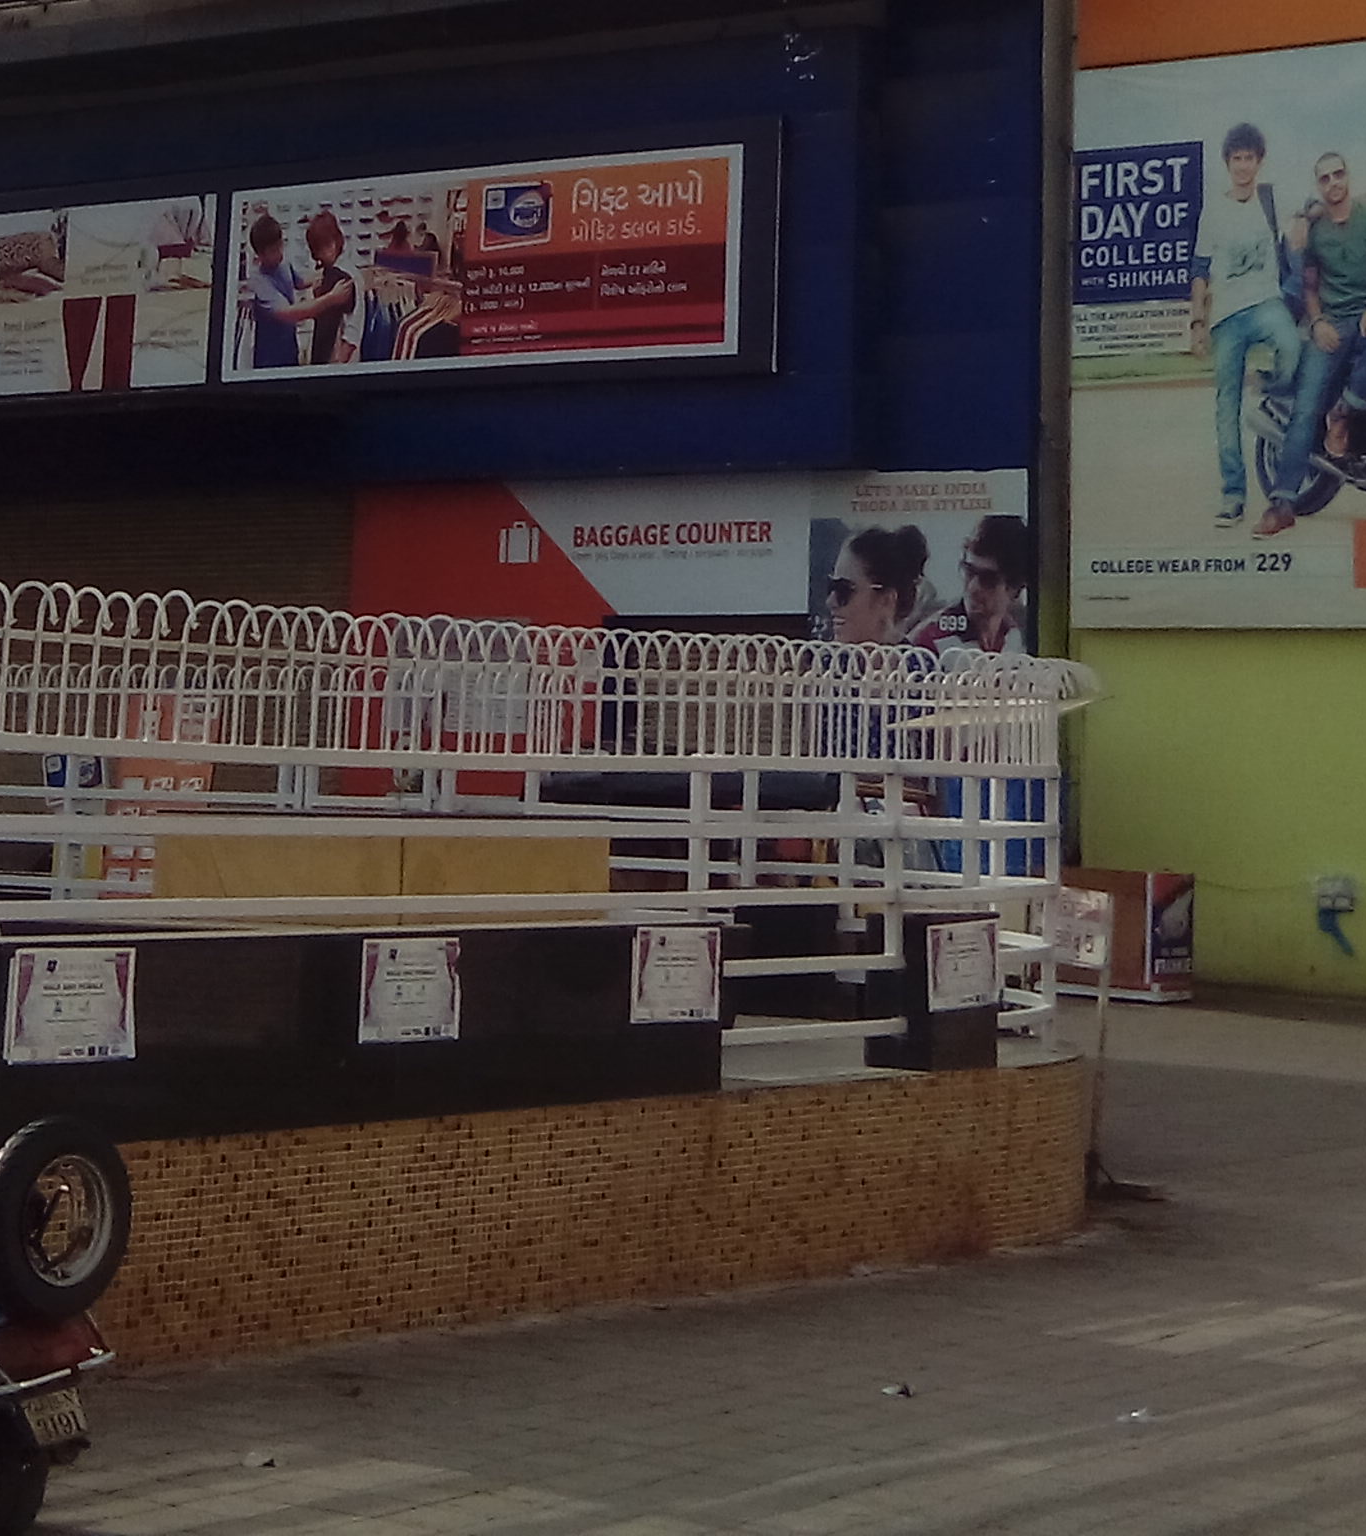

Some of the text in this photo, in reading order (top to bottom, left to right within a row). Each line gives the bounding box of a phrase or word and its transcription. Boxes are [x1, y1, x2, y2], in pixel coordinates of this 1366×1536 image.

[1080, 156, 1190, 200] FIRST
[1080, 201, 1190, 241] DAY OF
[1080, 240, 1189, 268] COLLEGE
[1107, 268, 1190, 289] SHIKHAR
[572, 520, 773, 548] BAGGAGE COUNTER
[1090, 552, 1292, 574] COLLEGE WEAR FROM 229
[938, 615, 968, 632] 699
